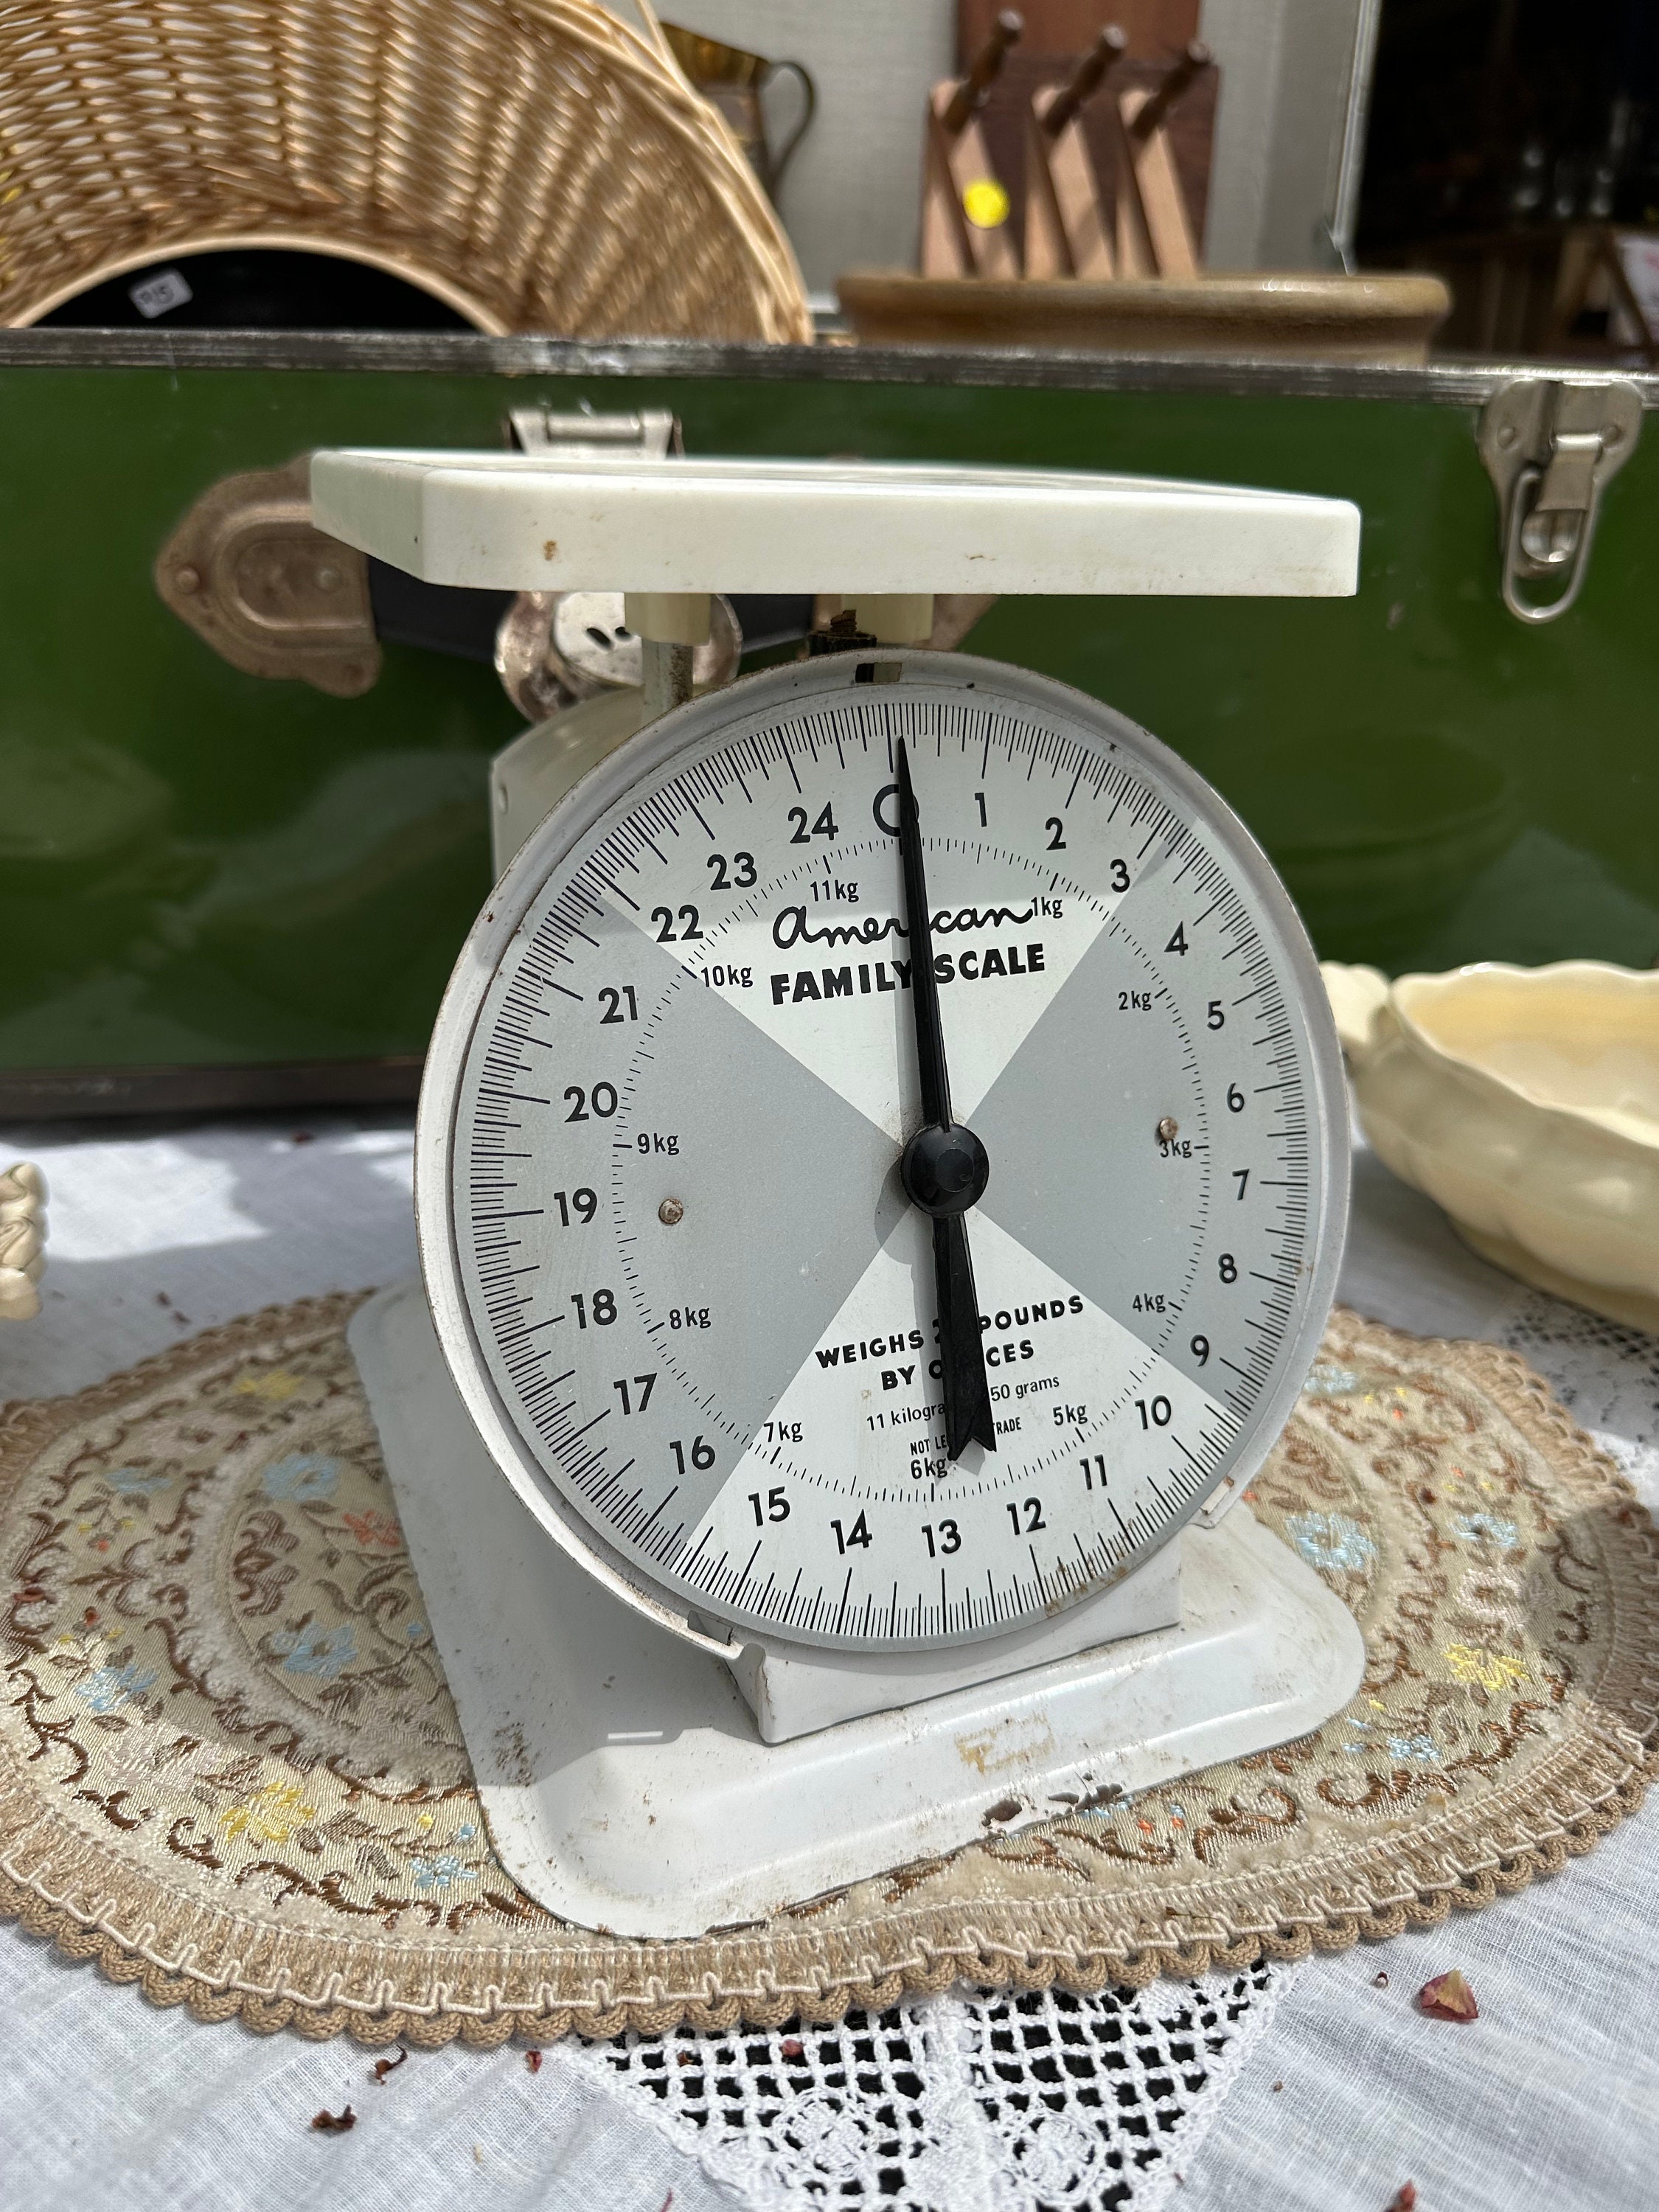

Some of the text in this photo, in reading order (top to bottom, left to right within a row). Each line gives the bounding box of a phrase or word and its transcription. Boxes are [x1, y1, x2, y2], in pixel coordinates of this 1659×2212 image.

[788, 801, 838, 844] 24
[974, 793, 987, 827] 1
[1046, 818, 1065, 850] 2
[708, 852, 757, 890] 23
[1110, 859, 1130, 892] 3
[810, 879, 859, 902] 11kg
[1032, 896, 1062, 918] 1kg
[651, 904, 703, 943] 22
[1165, 922, 1188, 956] 4
[700, 963, 754, 988] 10kg
[771, 943, 1045, 1006] FAMILY SCALE
[599, 986, 638, 1024] 21
[1119, 990, 1151, 1012] 2kg
[1206, 1000, 1225, 1031] 5
[564, 1082, 618, 1122] 20
[1227, 1082, 1244, 1112] 6
[638, 1133, 679, 1155] 9kg
[1159, 1139, 1192, 1158] 3kg
[1232, 1169, 1250, 1200] 7
[554, 1187, 598, 1226] 19
[1218, 1253, 1237, 1284] 8
[571, 1289, 617, 1329] 18
[669, 1307, 710, 1329] 8kg
[1133, 1293, 1166, 1313] 4kg
[815, 1329, 924, 1368] WEIGHS
[979, 1295, 1084, 1334] POUNDS
[881, 1339, 1034, 1390] BY OCES
[1191, 1334, 1209, 1367] 9
[613, 1373, 657, 1415] 17
[866, 1375, 1060, 1431] 11 kilogra 50 grams
[1053, 1404, 1087, 1426] 5kg
[1135, 1396, 1172, 1430] 10
[763, 1422, 803, 1442] 7kg
[910, 1439, 930, 1455] NOT
[993, 1417, 1021, 1434] RADE
[670, 1436, 715, 1476] 16
[910, 1457, 948, 1478] 6kg
[1080, 1455, 1107, 1489] 11
[748, 1486, 790, 1526] 15
[1006, 1497, 1046, 1535] 12
[831, 1509, 872, 1554] 14
[922, 1519, 961, 1557] 13
